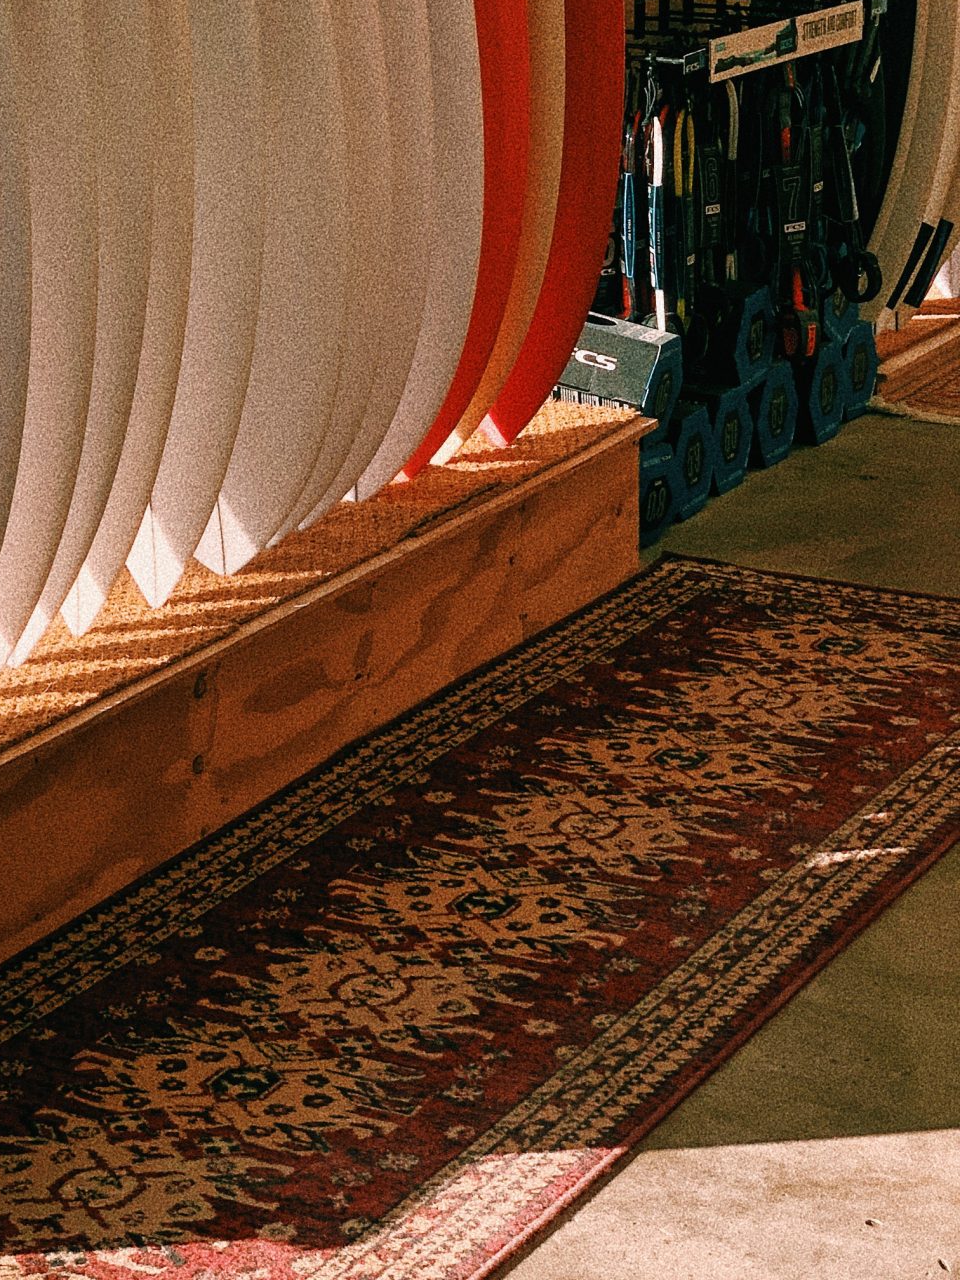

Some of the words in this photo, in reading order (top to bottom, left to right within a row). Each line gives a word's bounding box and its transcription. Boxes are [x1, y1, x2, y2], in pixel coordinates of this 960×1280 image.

[685, 63, 700, 73] FCS
[785, 223, 804, 232] FCS
[572, 347, 618, 371] CS
